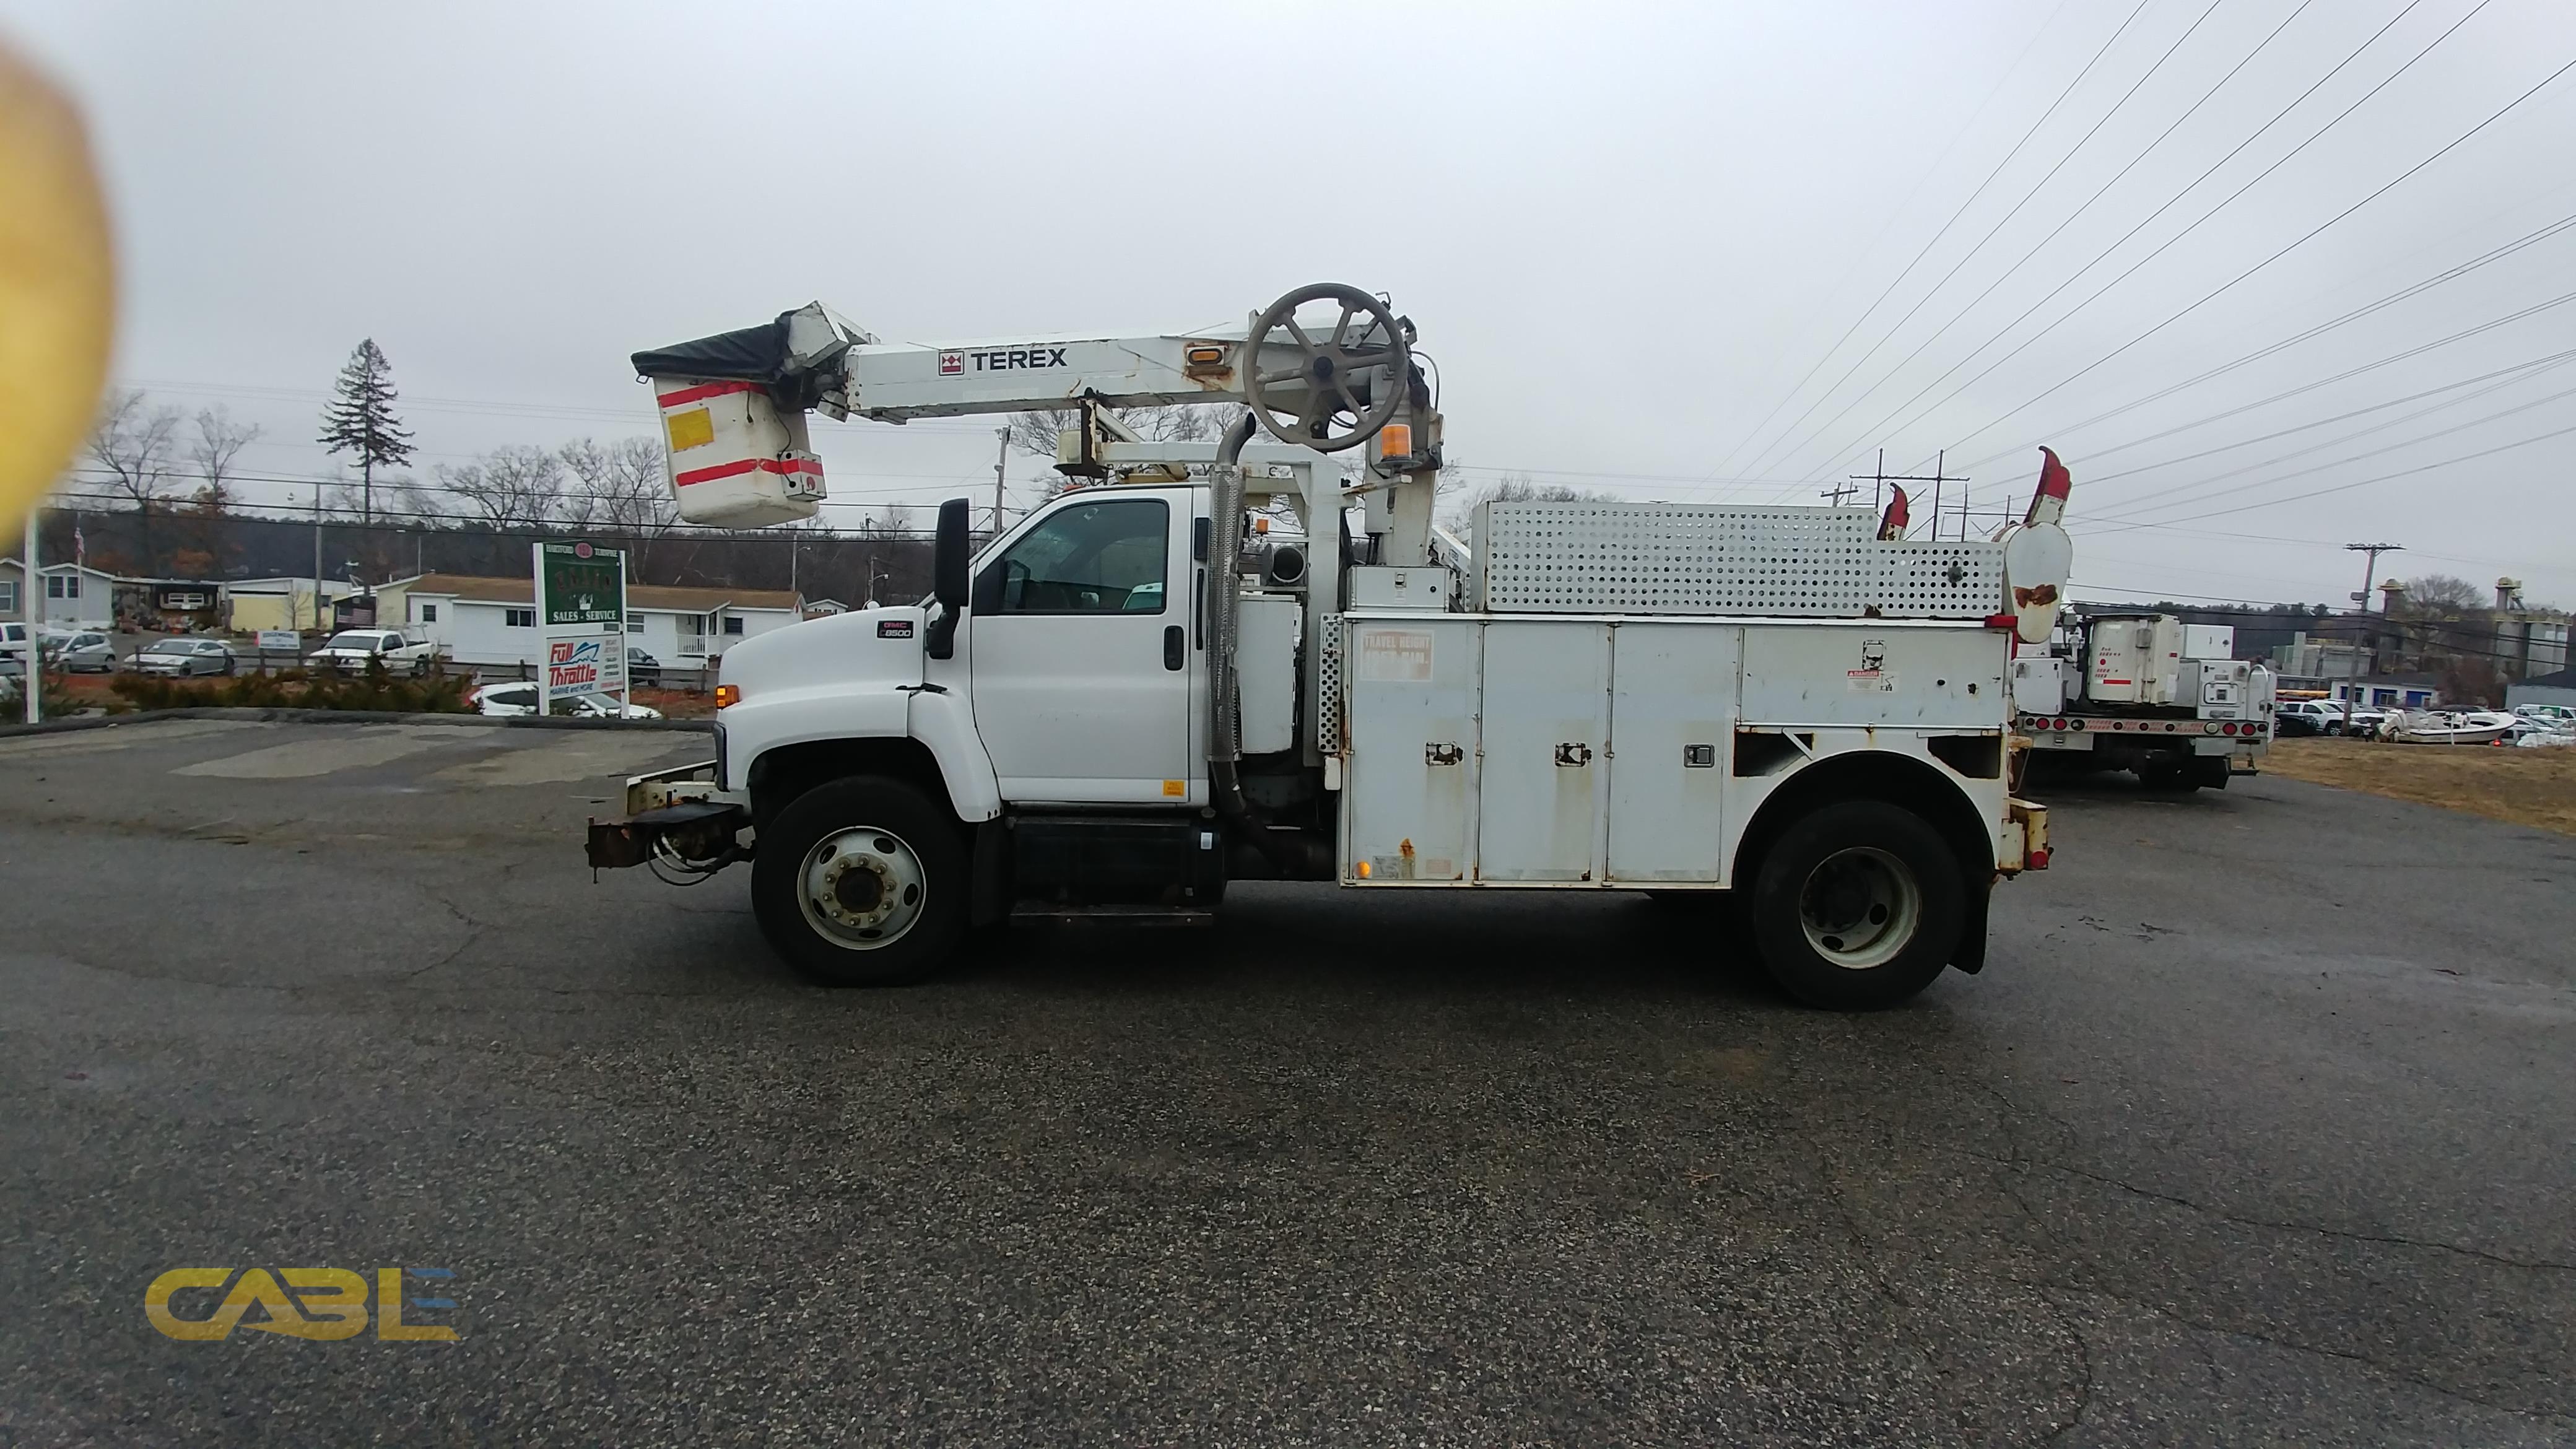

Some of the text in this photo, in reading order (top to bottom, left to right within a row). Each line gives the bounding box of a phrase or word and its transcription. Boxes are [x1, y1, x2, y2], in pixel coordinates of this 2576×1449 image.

[970, 348, 1068, 371] TEREX
[553, 611, 578, 622] SALES
[585, 610, 616, 620] SERVICE
[878, 629, 912, 637] C8500
[1364, 635, 1430, 650] TRAVEL HEIGHT
[550, 642, 574, 664] Full
[549, 663, 598, 687] Throttle
